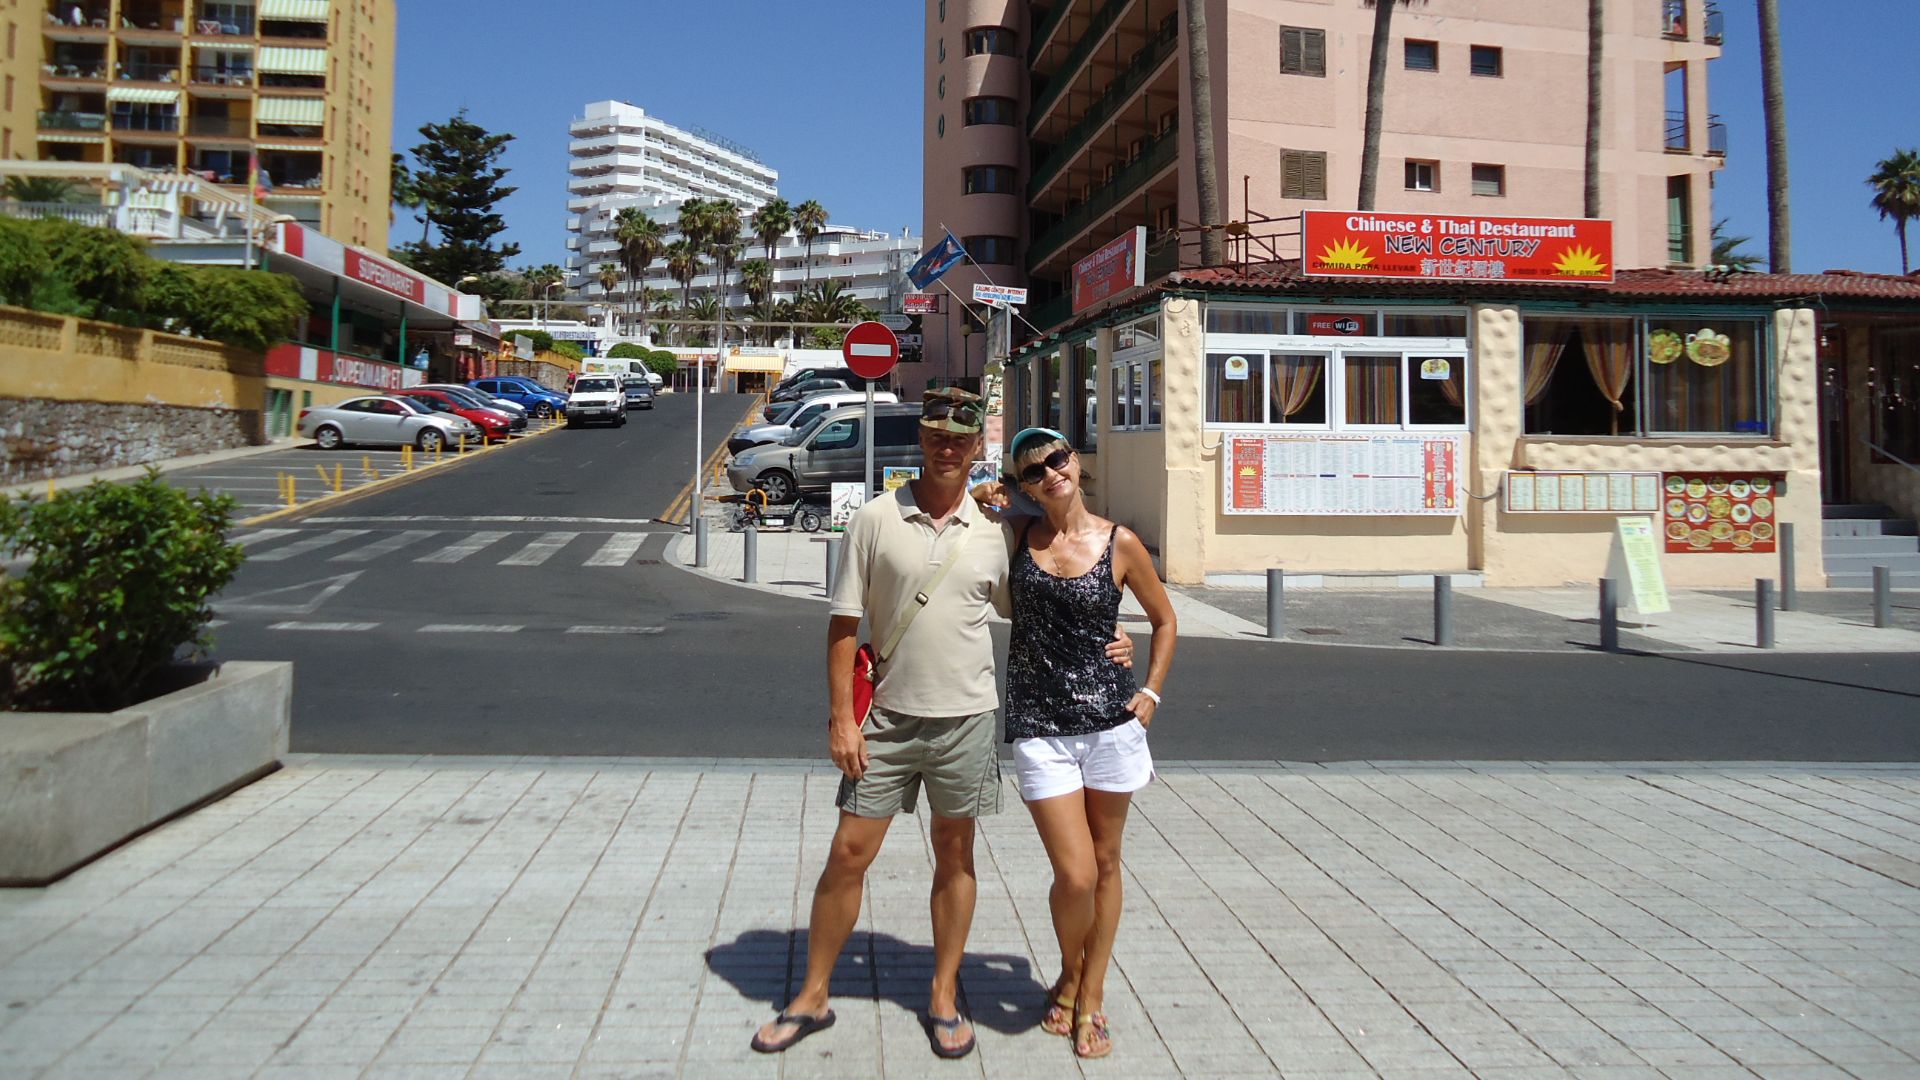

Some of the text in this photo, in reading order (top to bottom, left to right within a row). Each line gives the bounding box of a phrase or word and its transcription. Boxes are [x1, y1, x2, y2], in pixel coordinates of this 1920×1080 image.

[1346, 216, 1576, 238] Chinese & Thai Restaurant
[1384, 234, 1541, 257] NEW CENTURY
[358, 257, 415, 297] SUPERMARKET
[1312, 261, 1416, 272] COMIDA PARA LLEVAR
[1312, 321, 1331, 329] FREE
[336, 358, 402, 390] SUPERMARKET
